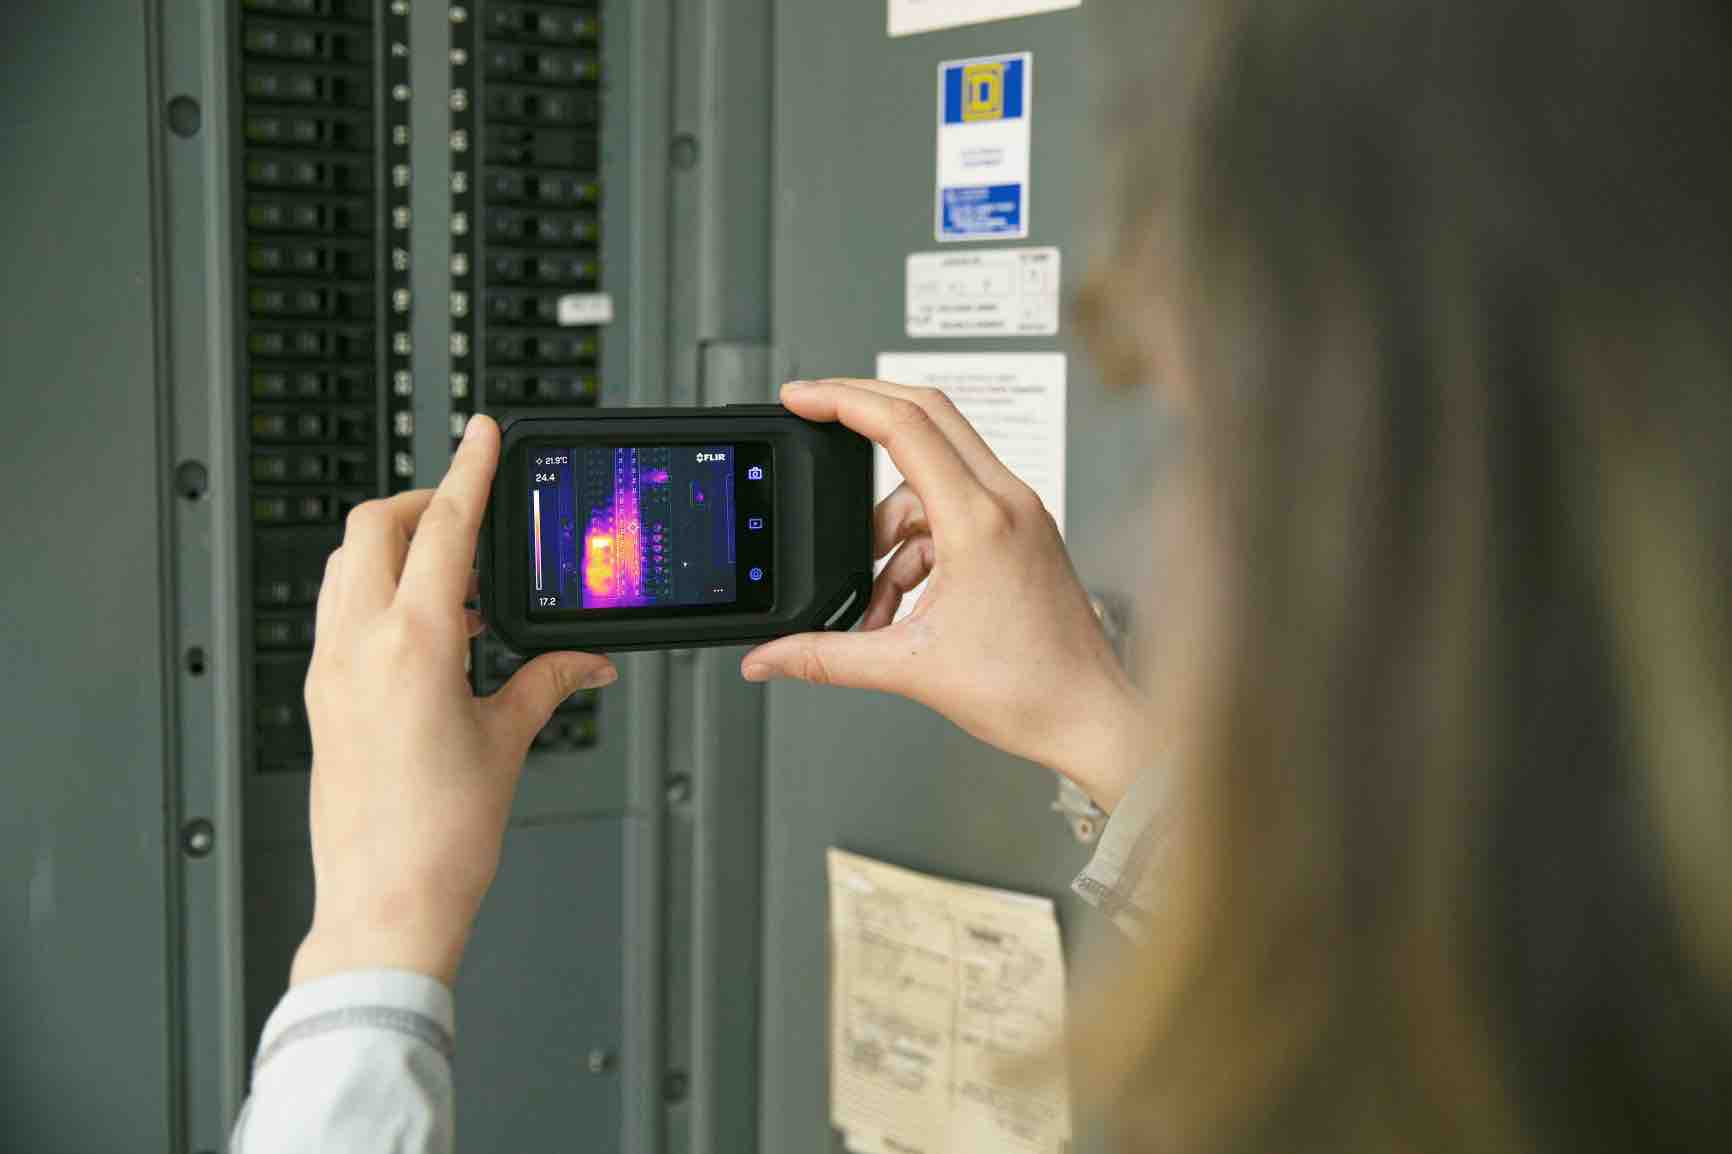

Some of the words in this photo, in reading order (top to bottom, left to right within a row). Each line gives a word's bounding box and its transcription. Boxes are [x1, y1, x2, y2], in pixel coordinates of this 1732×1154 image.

[545, 456, 568, 465] 21.9°C
[703, 453, 726, 461] FLIR
[535, 473, 555, 482] 24.4
[539, 597, 556, 606] 17.2
